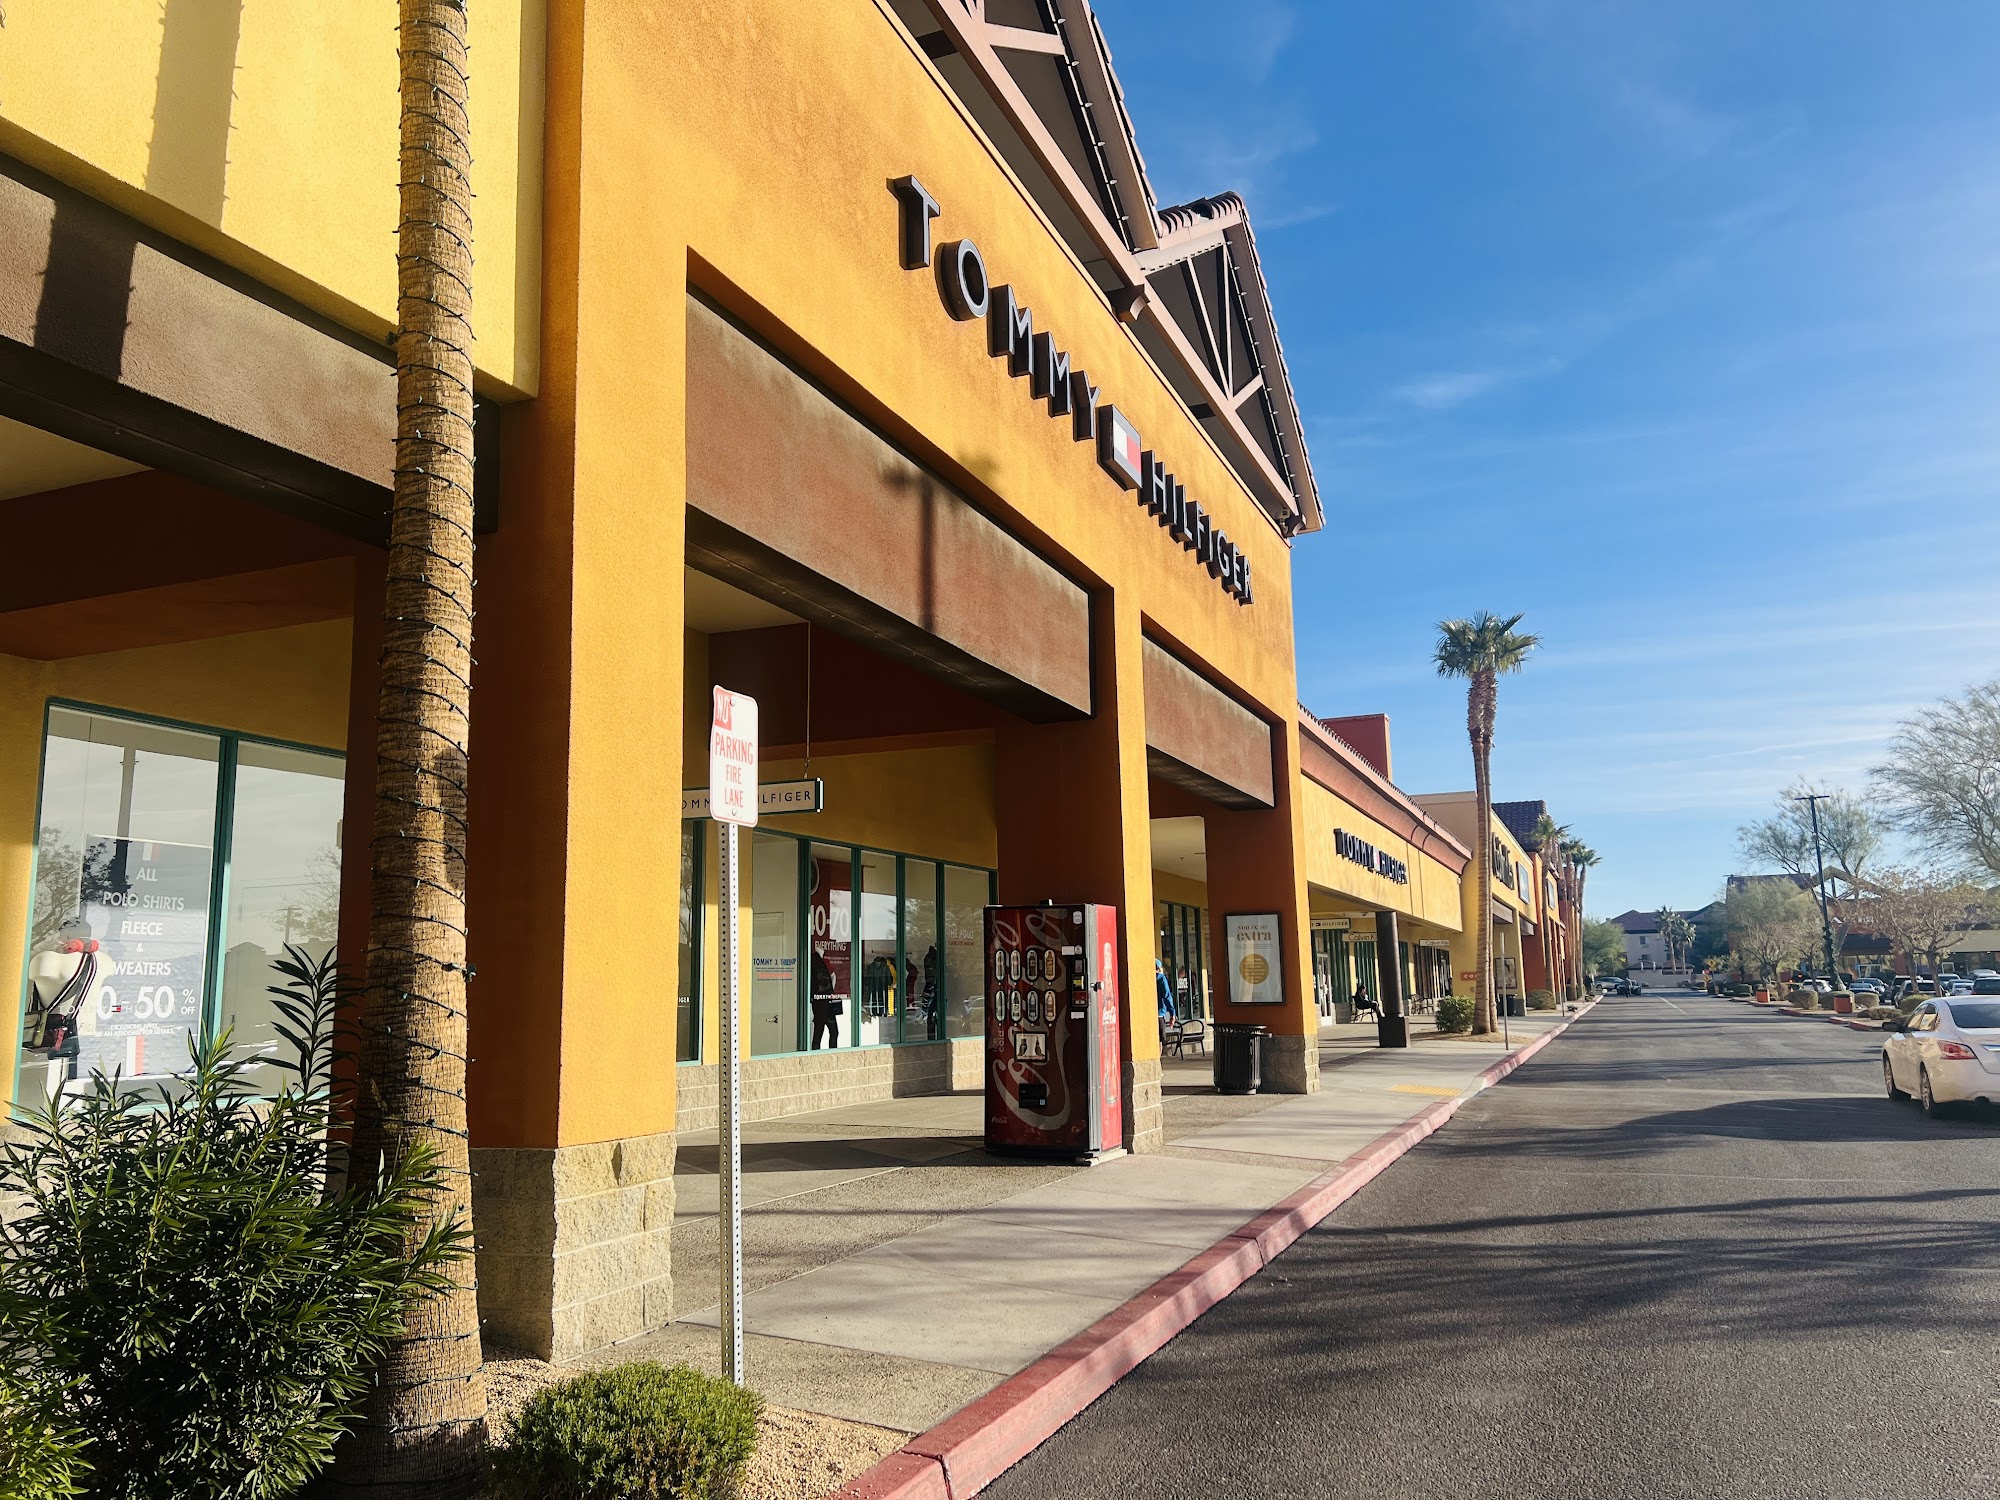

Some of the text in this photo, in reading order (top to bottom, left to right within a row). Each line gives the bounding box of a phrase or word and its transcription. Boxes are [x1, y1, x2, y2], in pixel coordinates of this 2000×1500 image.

[887, 174, 1254, 605] TOMMY HILFIGER
[716, 692, 731, 725] NO
[715, 731, 753, 765] PARKING
[726, 764, 742, 785] FIRE
[682, 790, 811, 809] OMM LFIGER
[724, 786, 744, 808] LANE
[1334, 828, 1374, 873] TOMMY
[136, 866, 158, 882] ALL
[102, 891, 185, 911] POLO SHIRTS
[121, 920, 163, 936] FLEECE
[1237, 931, 1272, 941] extra
[136, 942, 144, 953] &
[815, 941, 847, 952] EVERYTHING
[113, 961, 172, 976] WEATERS
[753, 958, 773, 967] TOMMY
[182, 988, 196, 1004] %
[180, 1006, 196, 1015] OFF
